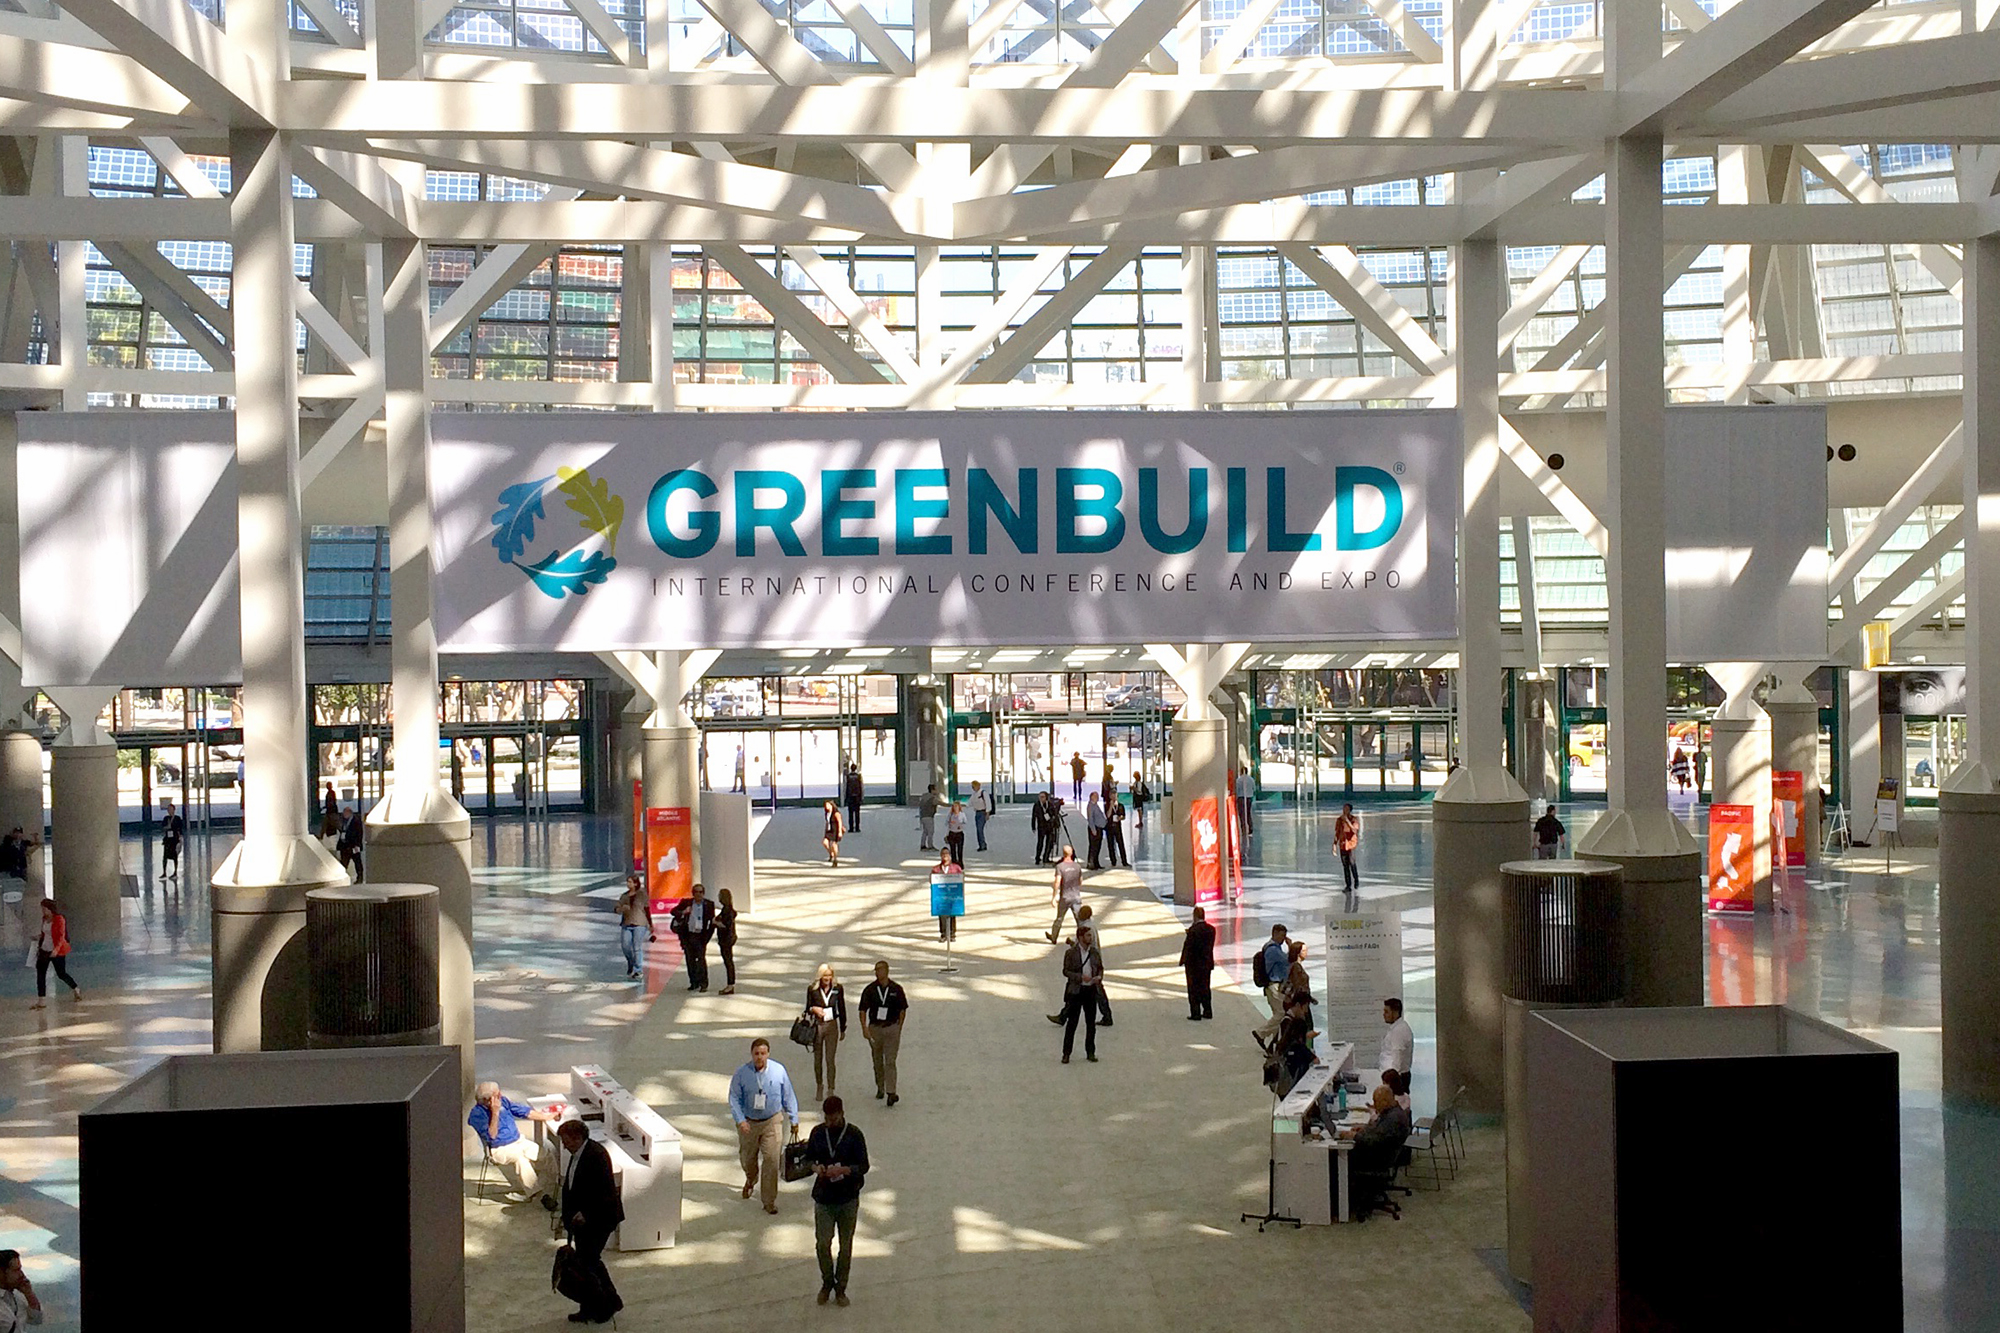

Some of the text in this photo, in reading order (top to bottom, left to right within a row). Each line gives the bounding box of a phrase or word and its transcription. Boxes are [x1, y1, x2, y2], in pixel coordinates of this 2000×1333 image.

[646, 465, 1404, 559] GREENBUILD
[652, 569, 1401, 597] INTERNATIONAL CONFERENCE AND EXPO
[1906, 692, 1946, 706] LOOK
